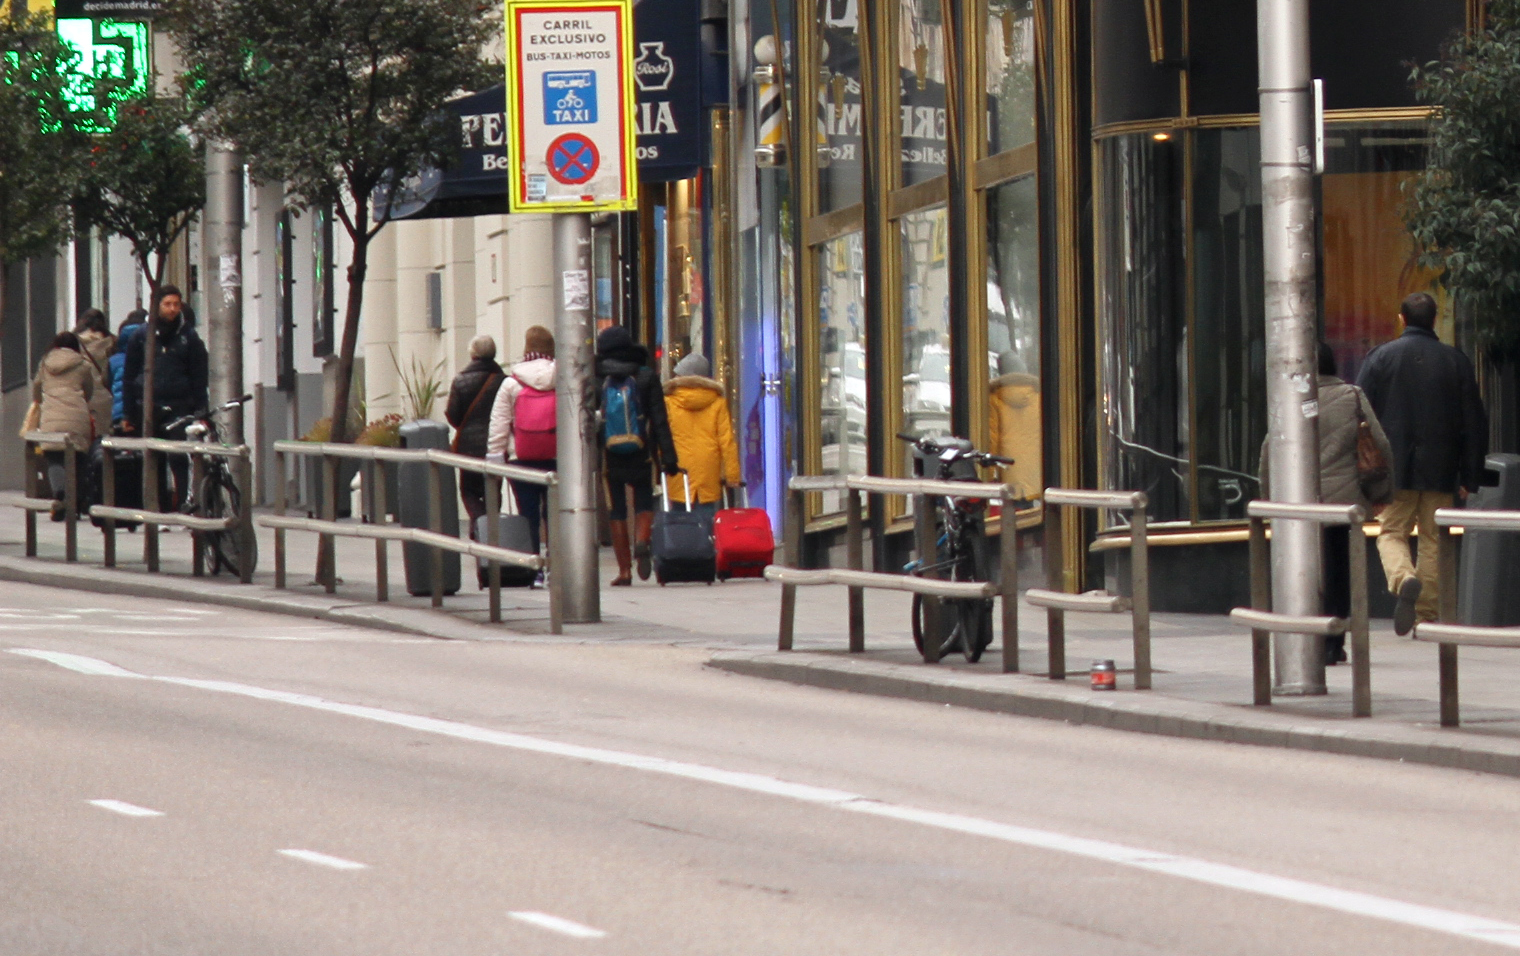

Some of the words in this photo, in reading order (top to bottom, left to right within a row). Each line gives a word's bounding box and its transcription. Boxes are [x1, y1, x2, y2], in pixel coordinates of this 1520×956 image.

[543, 20, 592, 30] CARRIL
[530, 33, 607, 45] EXCLUSIVO
[526, 50, 611, 62] BUS-TAXI-MOTOS
[552, 109, 589, 123] TAXI
